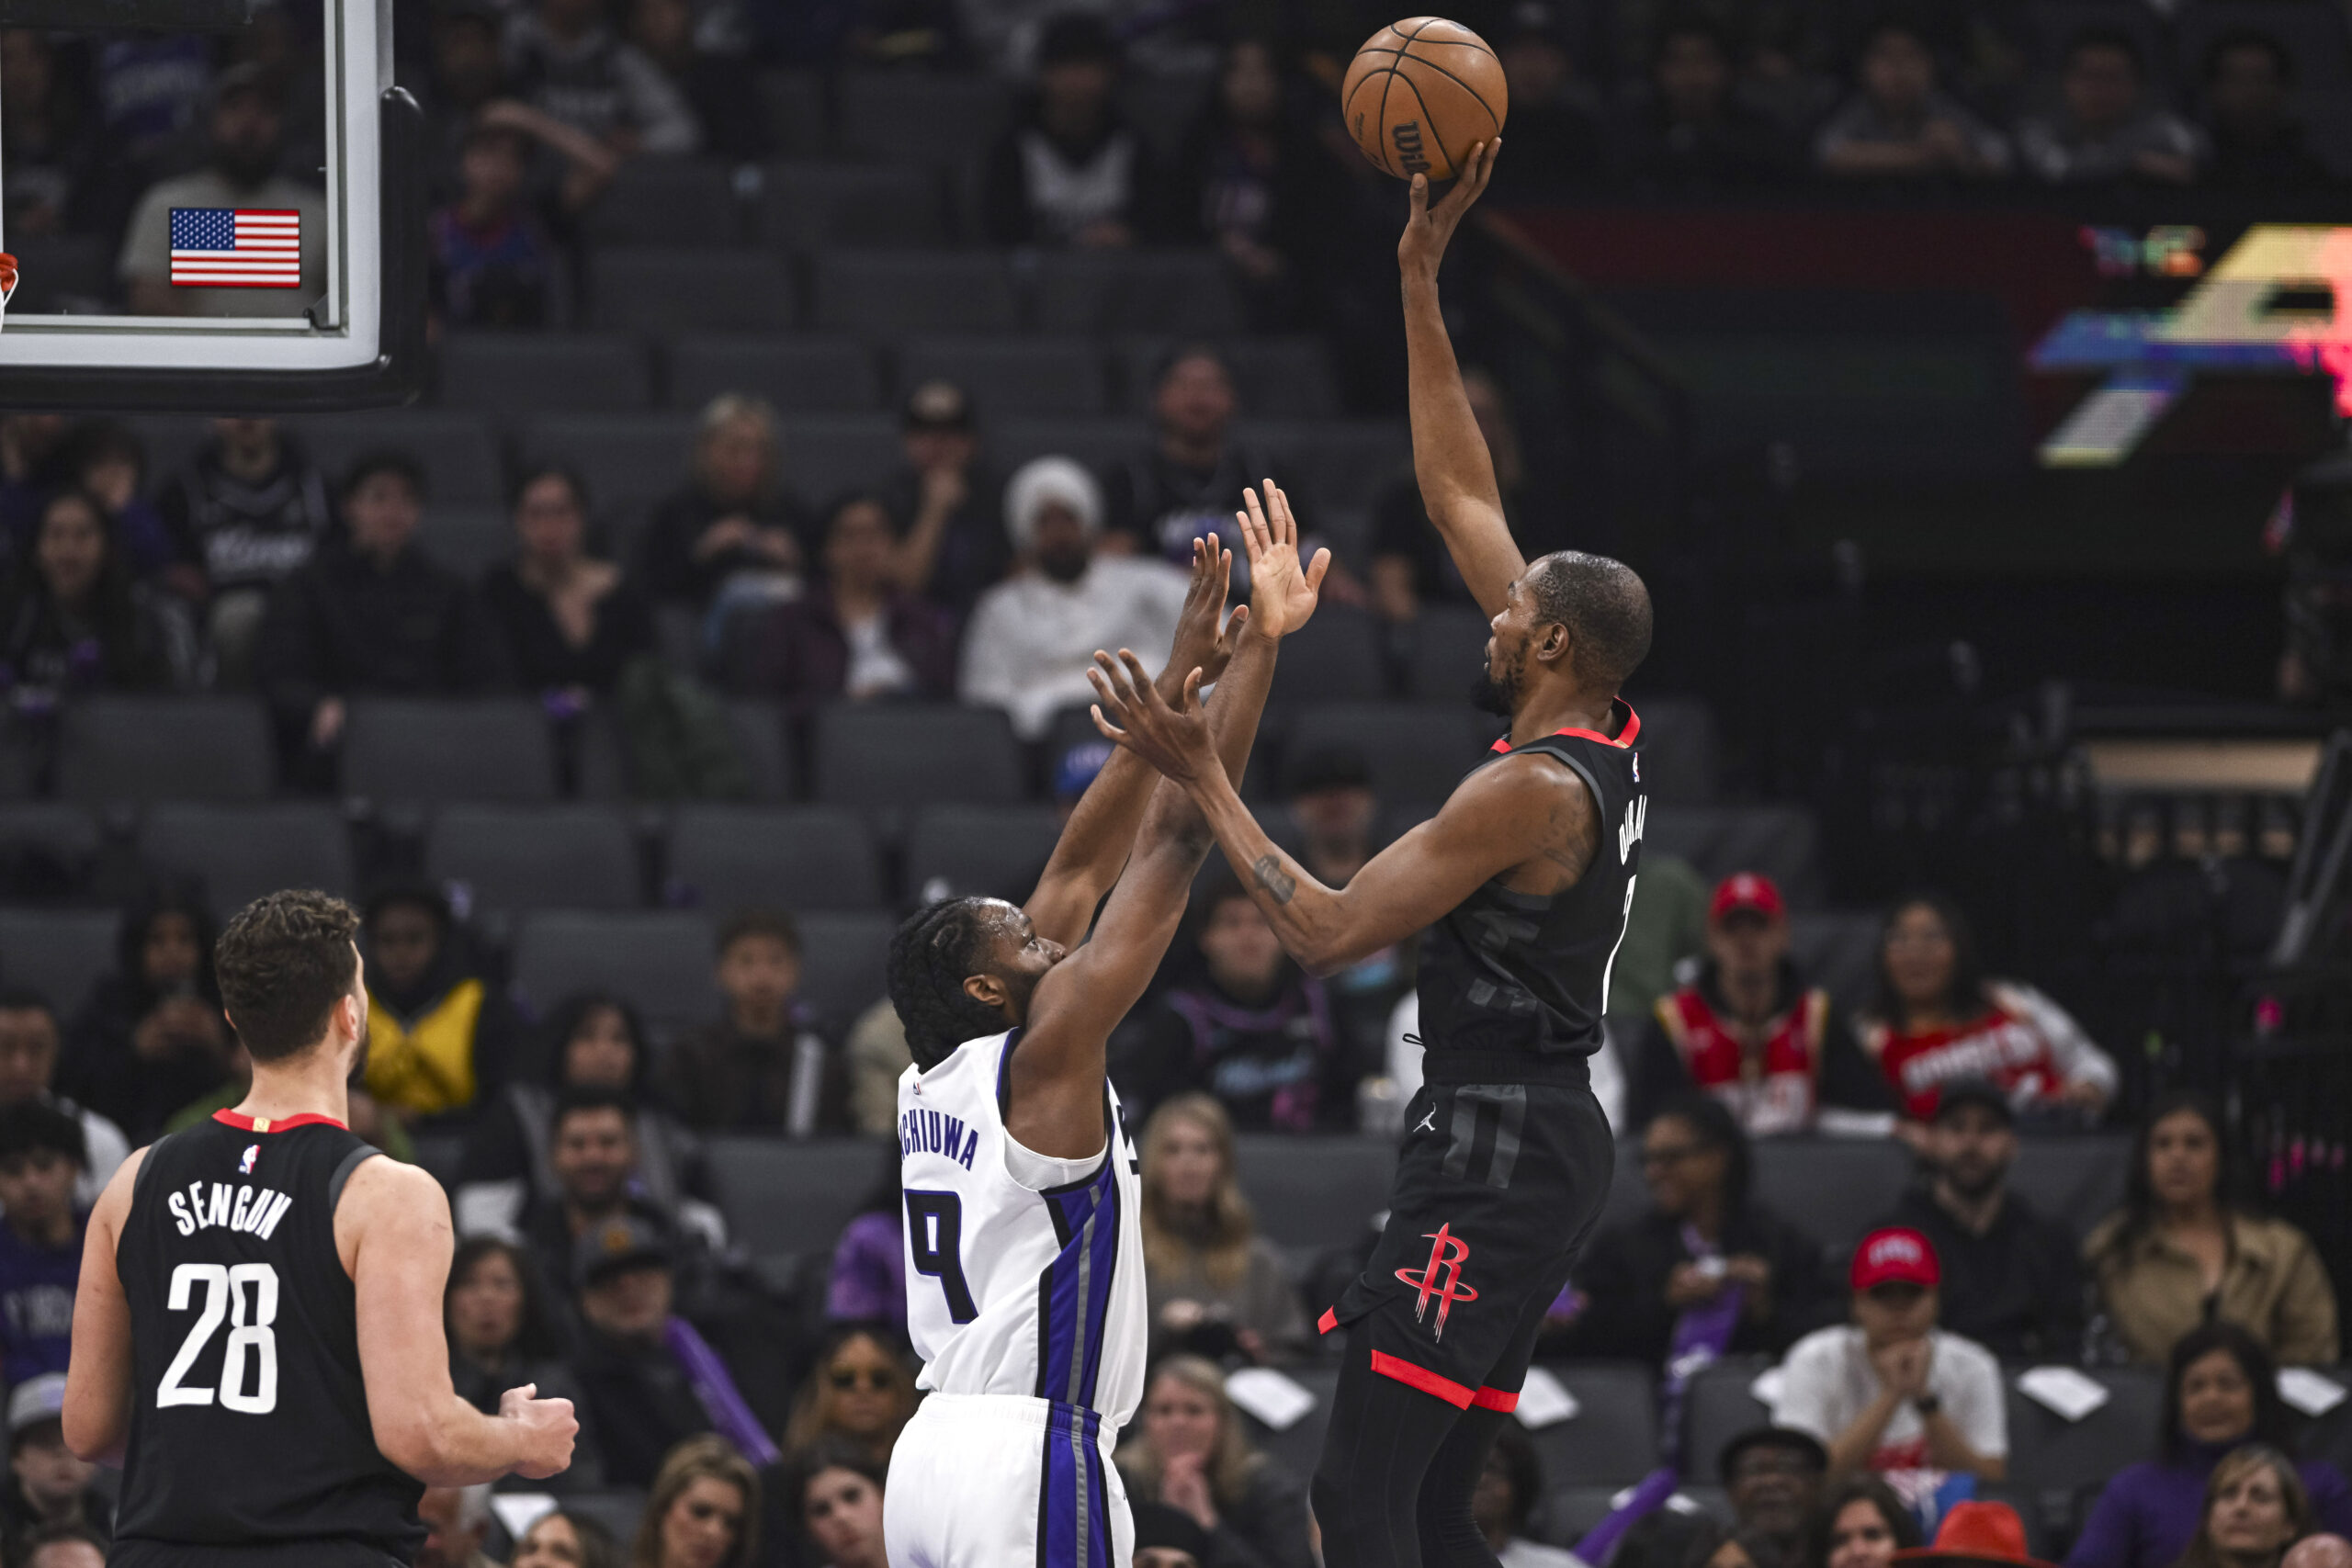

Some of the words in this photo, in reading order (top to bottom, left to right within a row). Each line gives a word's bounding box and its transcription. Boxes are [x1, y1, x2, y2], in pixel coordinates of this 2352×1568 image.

[1392, 119, 1431, 175] Wil
[168, 1180, 293, 1241] SENGUN
[903, 1188, 979, 1325] 9
[156, 1263, 279, 1415] 28
